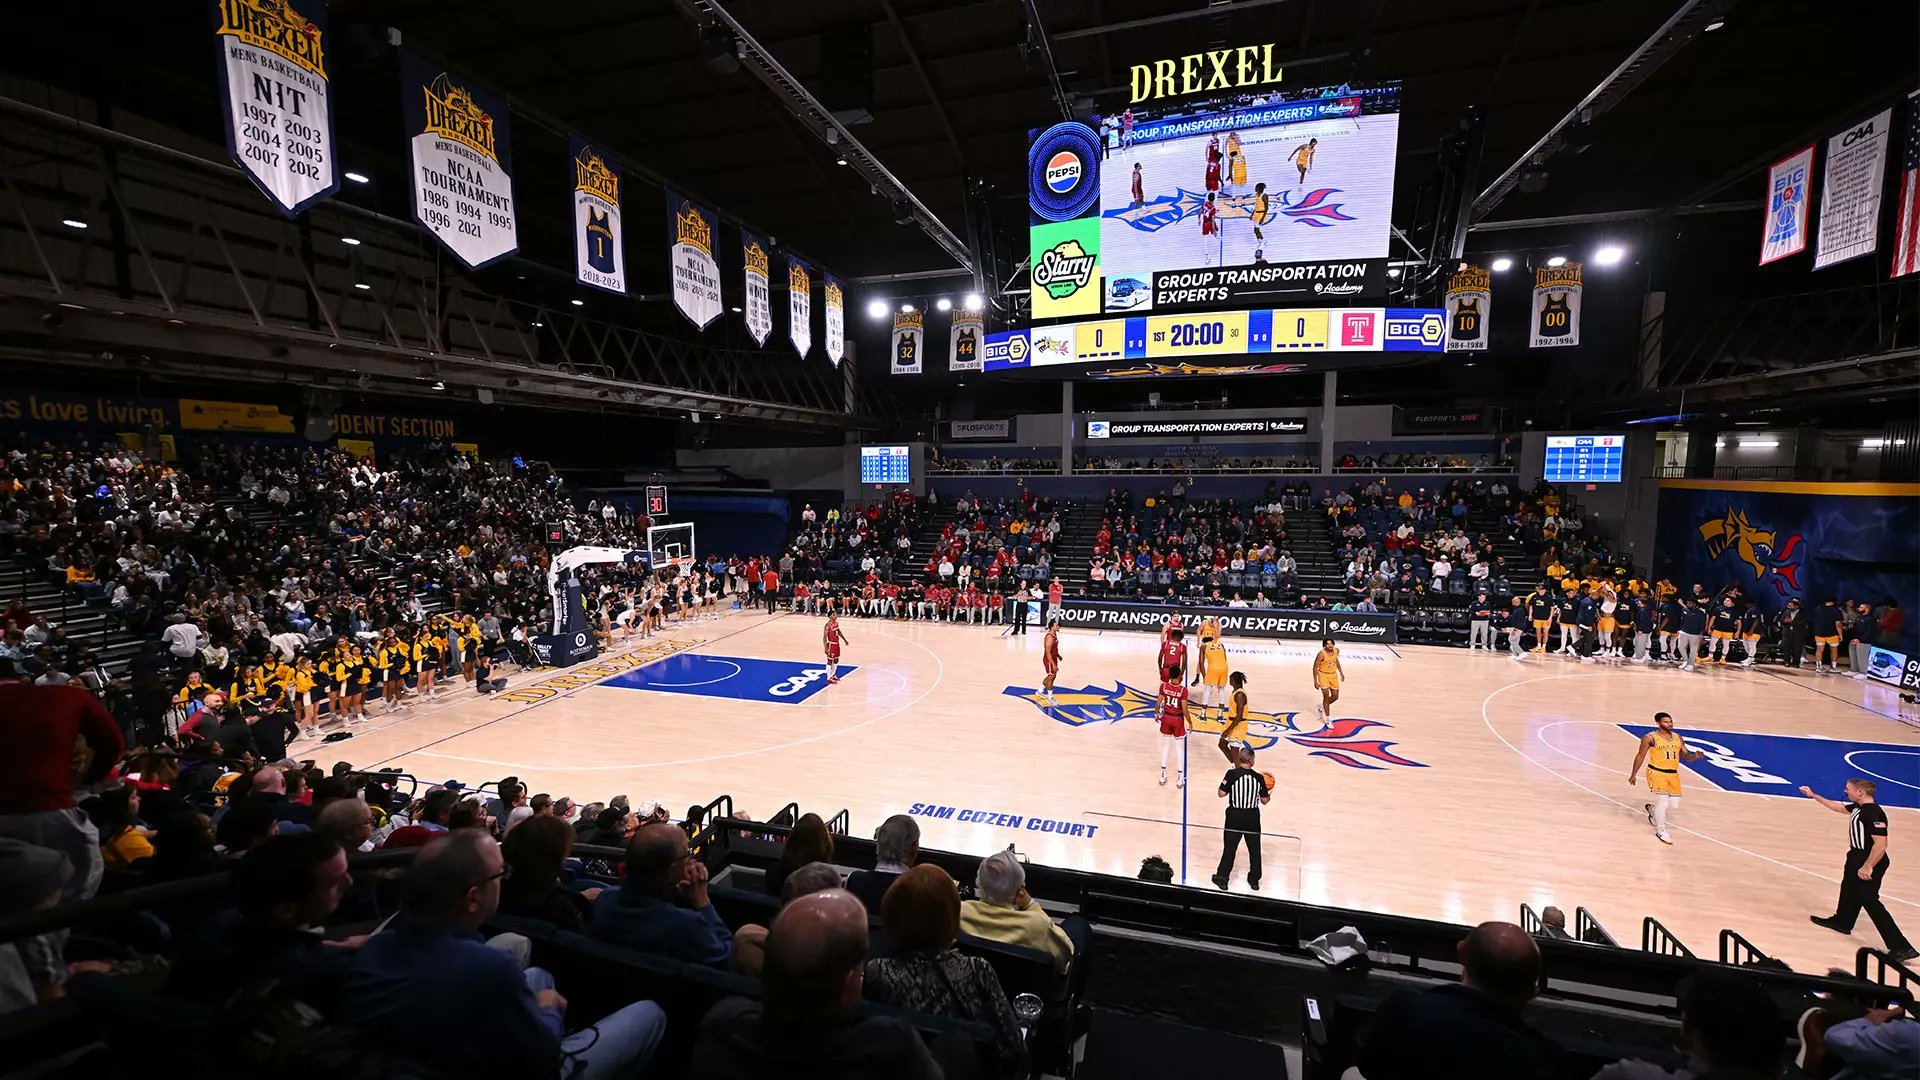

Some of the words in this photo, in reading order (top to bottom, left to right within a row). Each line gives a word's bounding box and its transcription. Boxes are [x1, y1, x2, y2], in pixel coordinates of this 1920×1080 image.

[230, 47, 258, 64] MENS
[260, 55, 324, 96] BASKETBALL
[1129, 43, 1283, 103] DREXEL
[252, 72, 306, 117] NIT
[242, 102, 277, 128] 1997
[285, 119, 321, 144] 2003
[427, 91, 494, 153] DREXEL
[1162, 112, 1261, 134] TRANSPORTATION
[1263, 106, 1313, 121] EXPERTS
[242, 122, 281, 148] 2004
[287, 139, 323, 163] 2005
[1842, 121, 1874, 148] CAA
[245, 142, 279, 167] 2007
[288, 158, 320, 180] 2012
[435, 141, 453, 153] MENS
[454, 145, 493, 173] BASKETBALL
[447, 158, 484, 187] NCAA
[1048, 165, 1079, 179] PEPSI
[1774, 168, 1804, 193] BIG
[422, 166, 510, 212] TOURNAMENT
[422, 188, 449, 209] 1986
[456, 200, 482, 220] 1994
[488, 211, 512, 230] 1995
[423, 208, 451, 228] 1996
[458, 219, 482, 238] 2021
[597, 237, 604, 258] 1
[687, 258, 704, 274] NCAA
[1034, 250, 1095, 286] Starry
[1158, 272, 1213, 289] GROUP
[1218, 264, 1367, 285] TRANSPORTATION
[582, 269, 621, 290] 2018-2023
[675, 265, 717, 289] TOURNAMENT
[1157, 287, 1229, 304] EXPERTS
[1324, 282, 1364, 294] Academy
[1297, 317, 1304, 337] 0
[1390, 324, 1421, 335] BIG
[1427, 324, 1436, 335] 5
[1460, 316, 1475, 331] 10
[1545, 312, 1566, 327] 00
[1096, 329, 1102, 347] 0
[1153, 331, 1166, 342] 1ST
[1170, 322, 1224, 347] 20:00
[1230, 328, 1239, 338] 30
[1535, 338, 1574, 346] 1992-1996
[901, 346, 913, 359] 32
[958, 343, 973, 355] 44
[986, 346, 1008, 357] BIG
[1013, 344, 1022, 353] 5
[28, 393, 89, 423] love
[1461, 413, 1478, 421] LIVE
[391, 416, 455, 437] SECTION
[962, 423, 1004, 432] FLOSPORTS
[1112, 425, 1141, 433] GROUP
[1143, 423, 1222, 433] TRANSPORTATION
[1223, 422, 1264, 431] EXPERTS
[1016, 477, 1023, 486] 2
[1187, 477, 1194, 486] 3
[1379, 476, 1387, 486] 4
[650, 498, 662, 512] 30
[1100, 610, 1241, 629] TRANSPOTAON
[1245, 617, 1321, 633] EXPERTS
[1340, 620, 1387, 636] Academy
[1170, 646, 1176, 655] 2
[500, 638, 707, 704] DREXEL
[1903, 673, 1920, 688] EX
[768, 669, 827, 696] CAA
[1165, 696, 1179, 708] 14
[1666, 751, 1676, 760] 11
[1682, 736, 1793, 784] CAA
[908, 803, 956, 820] SAM
[956, 809, 1023, 829] COZEN
[1026, 818, 1099, 838] COURT
